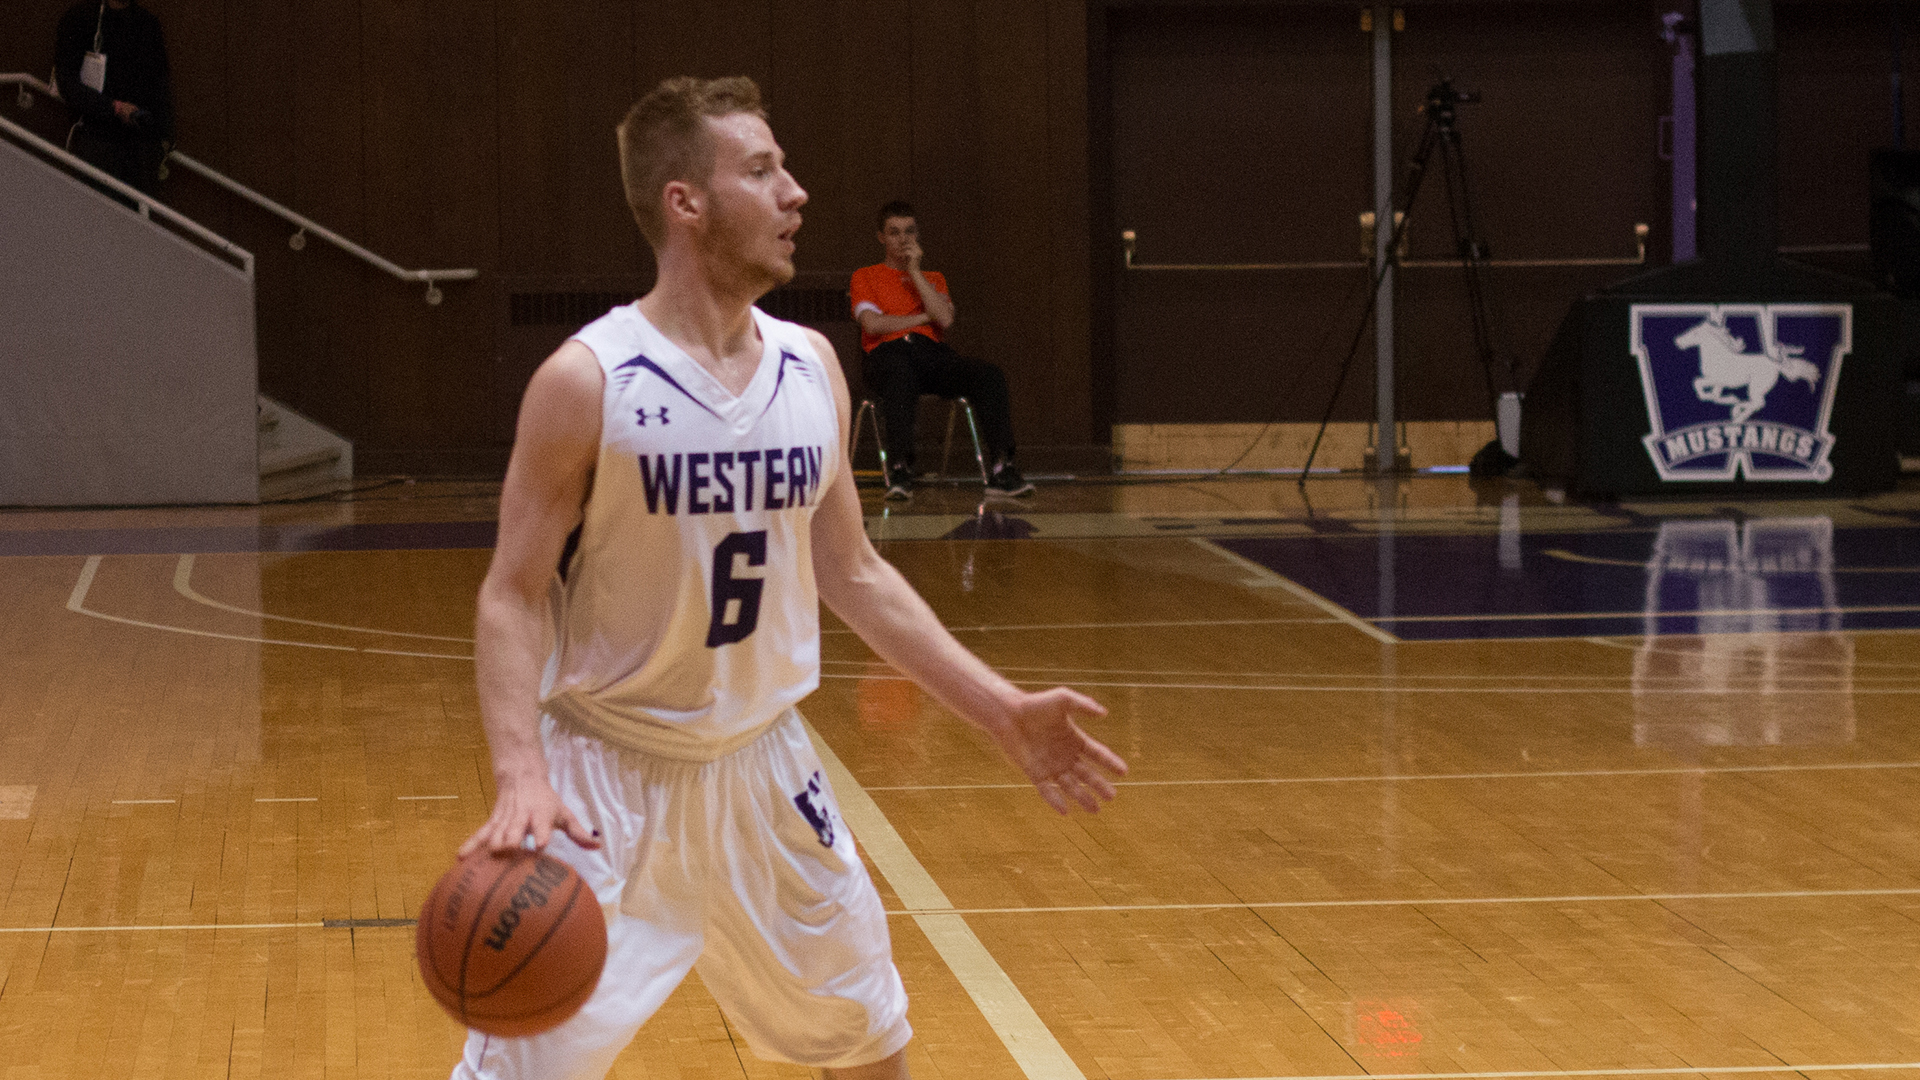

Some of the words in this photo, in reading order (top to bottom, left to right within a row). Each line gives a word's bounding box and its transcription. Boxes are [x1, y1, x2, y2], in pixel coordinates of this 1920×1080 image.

[638, 446, 821, 515] WESTERN
[1665, 426, 1814, 461] MUSTANGS
[705, 530, 767, 648] 6
[484, 858, 569, 952] Wilson
